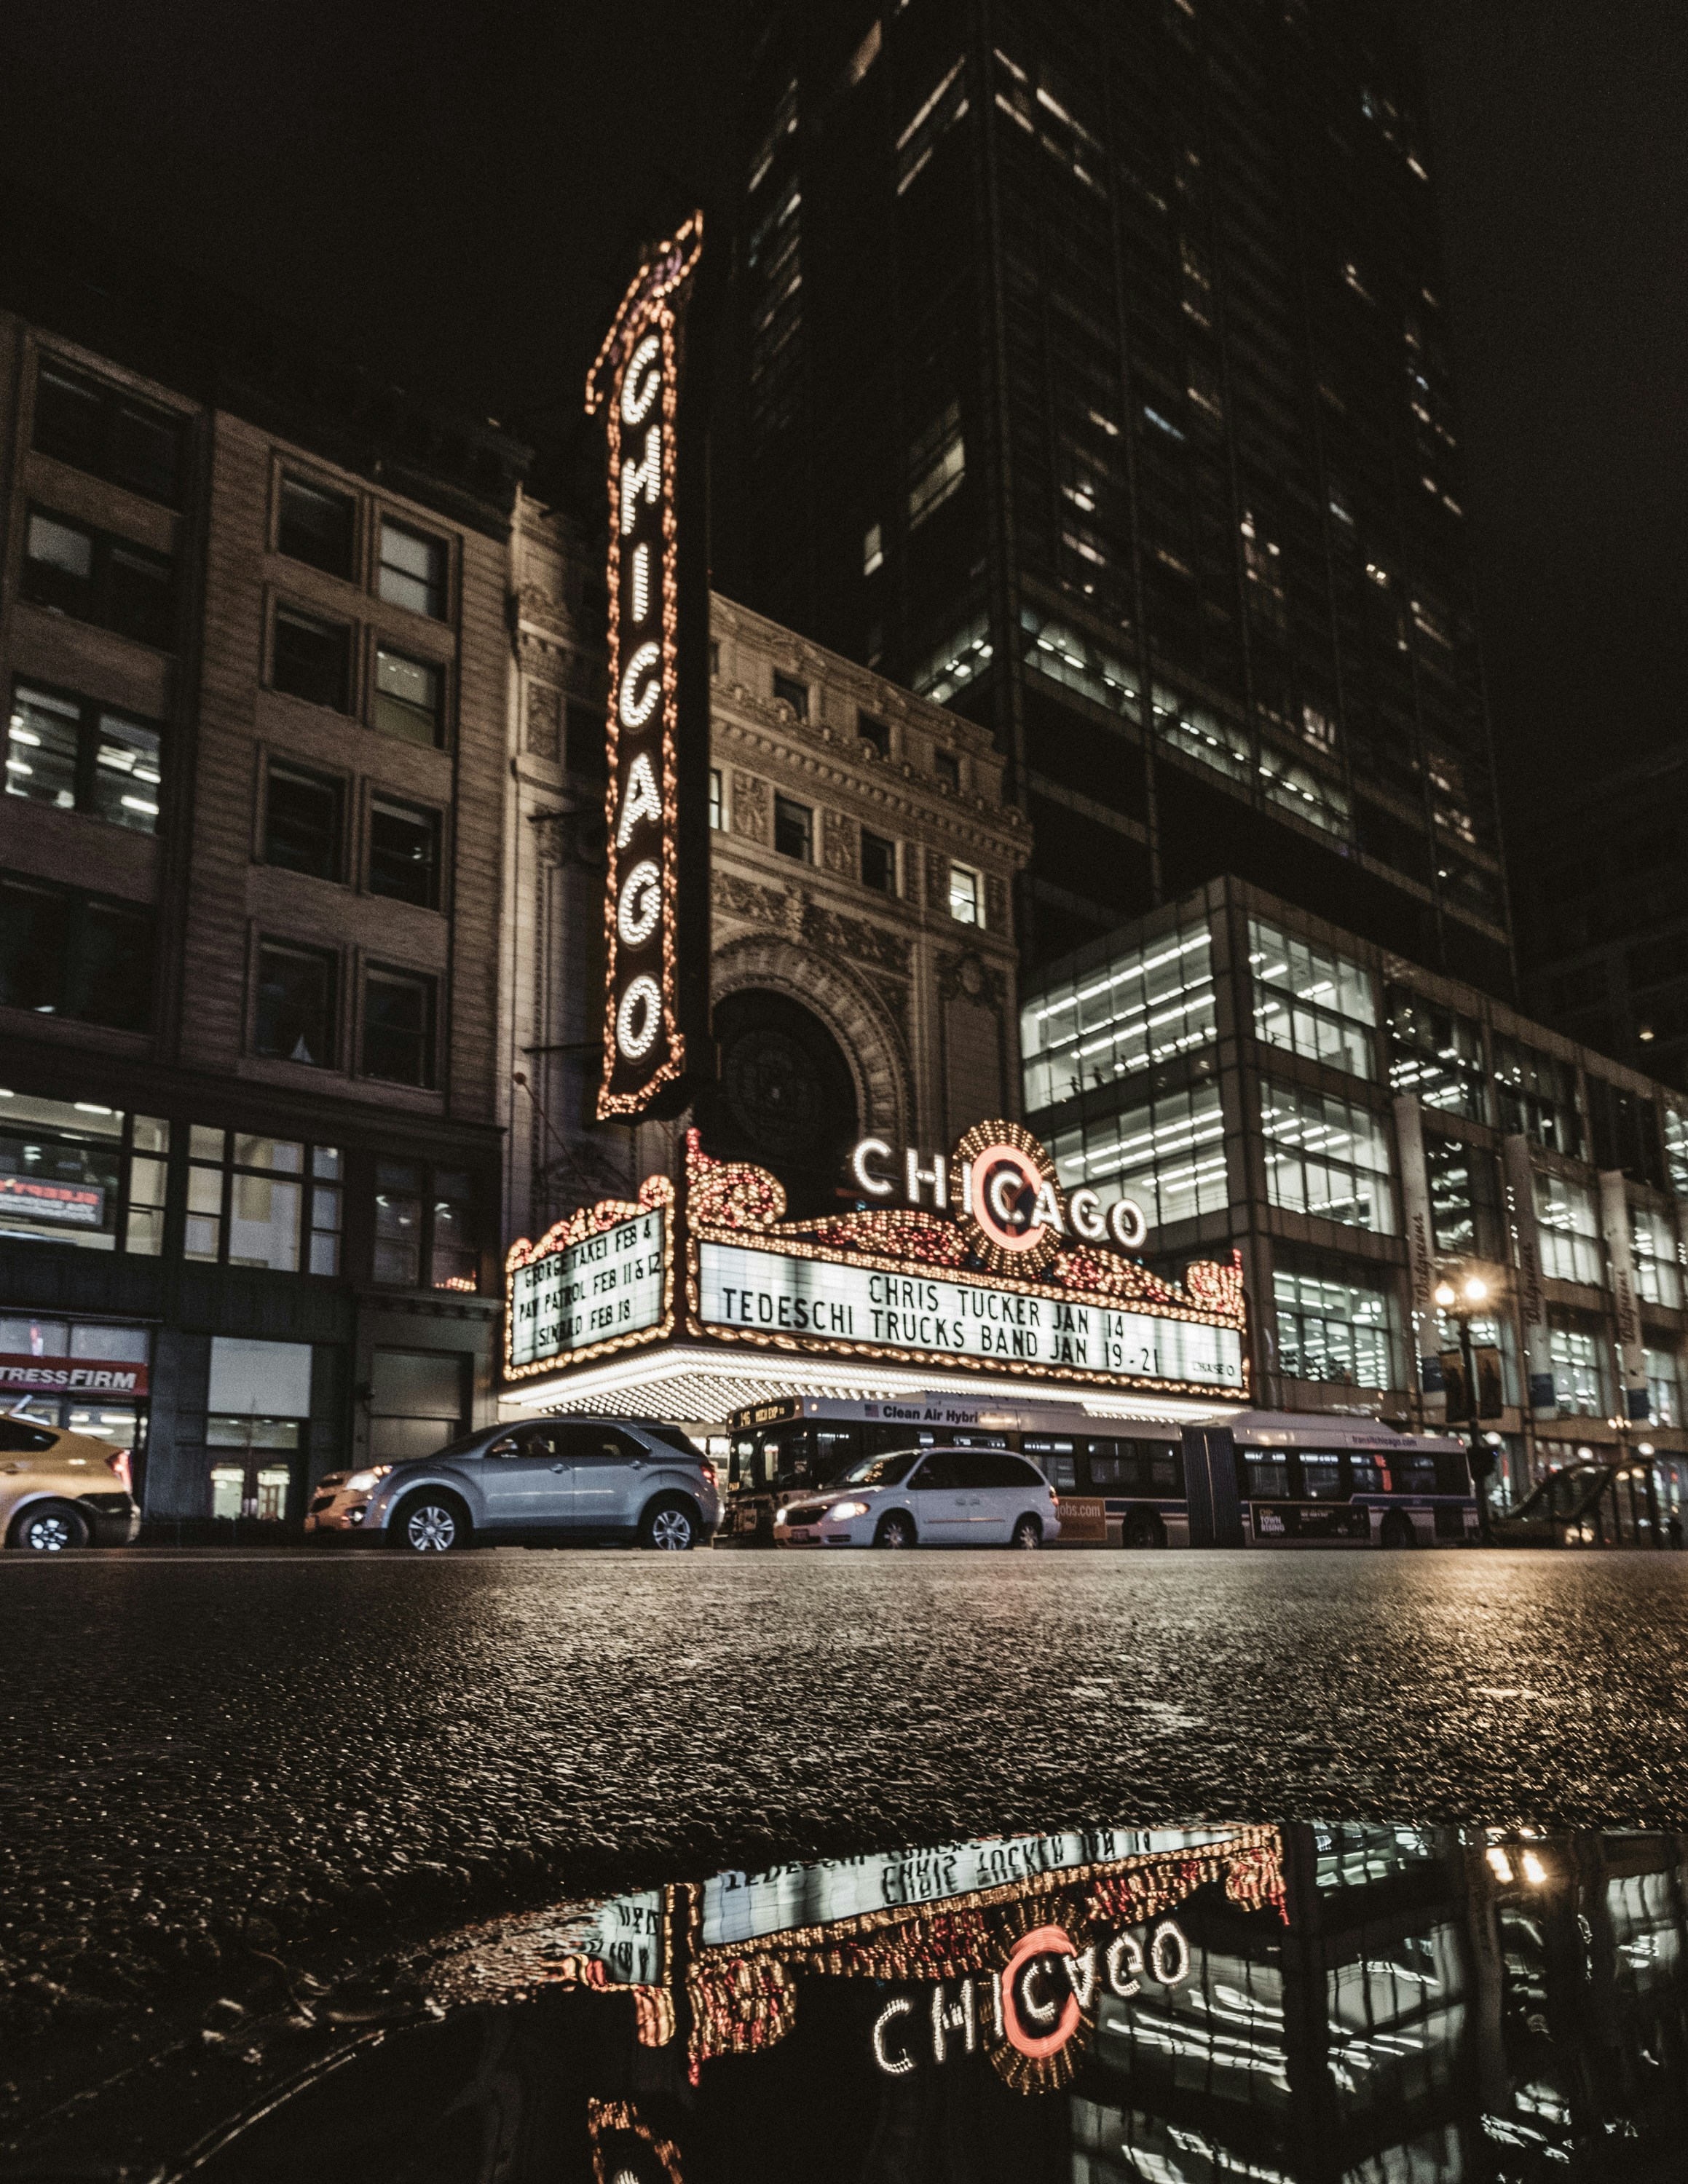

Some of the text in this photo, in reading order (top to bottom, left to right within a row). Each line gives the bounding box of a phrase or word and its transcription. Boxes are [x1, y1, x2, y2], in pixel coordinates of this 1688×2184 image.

[617, 333, 663, 1061] CHICAGO
[852, 1137, 1148, 1249] CHICAGO
[571, 1236, 607, 1270] TAKEI
[615, 1224, 637, 1253] FEB
[1411, 1213, 1433, 1305] Walgreens
[545, 1281, 586, 1313] PATROL
[593, 1268, 617, 1295] FEB
[624, 1262, 632, 1285] 11
[648, 1251, 662, 1276] 12
[869, 1275, 1124, 1339] CHRIS TUCKER JAN 14
[591, 1305, 613, 1331] FEB
[618, 1299, 631, 1323] 18
[722, 1287, 854, 1335] TEDESCHI
[869, 1309, 965, 1348] TRUCKS
[981, 1325, 1038, 1357] BAND
[1049, 1334, 1088, 1364] JAN
[883, 1405, 983, 1425] Clean Air Hybri
